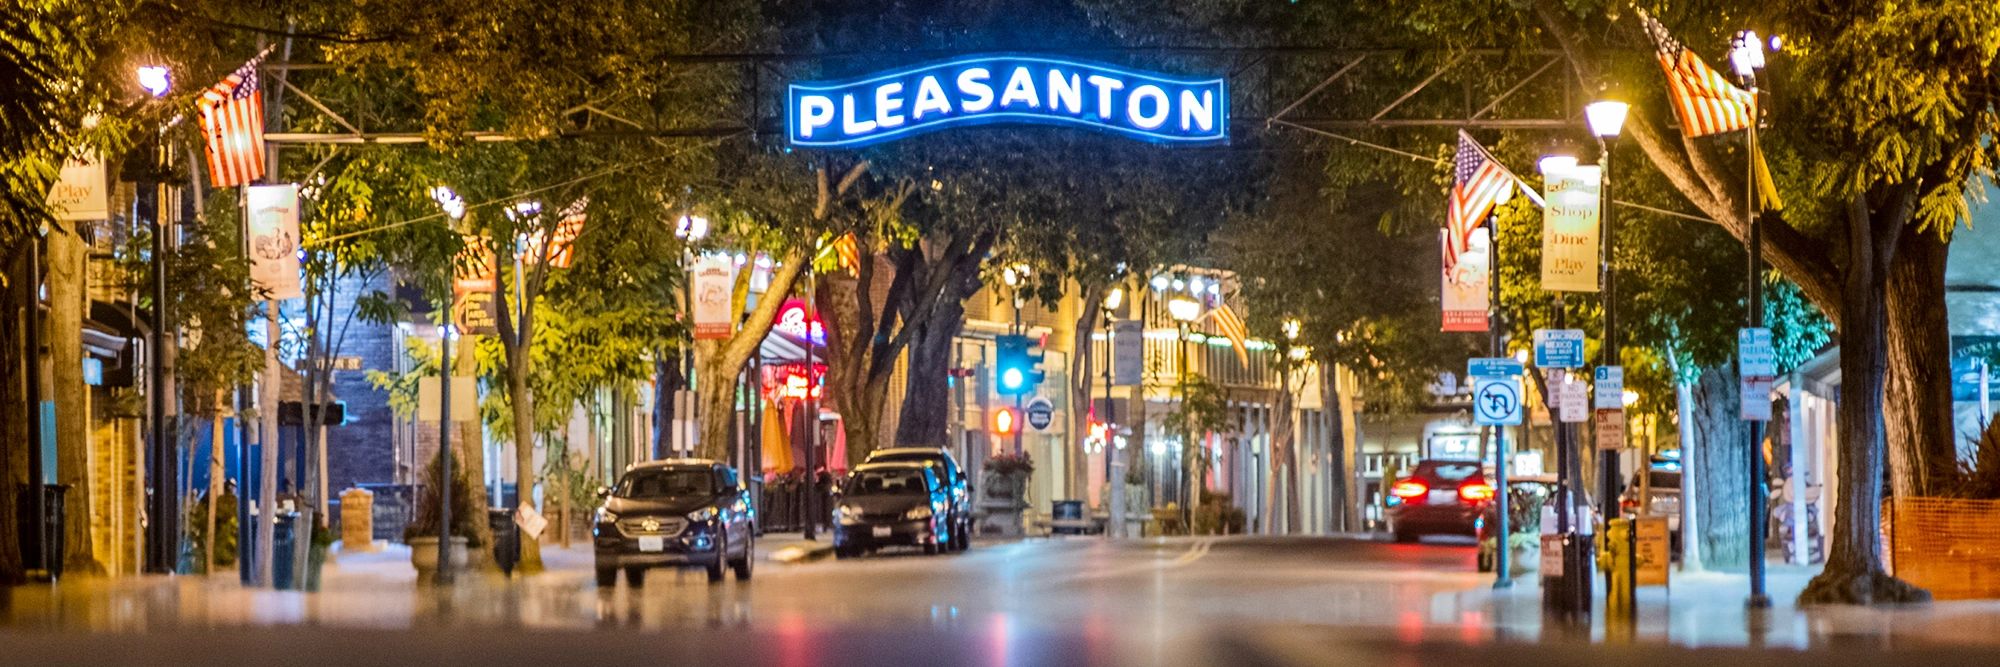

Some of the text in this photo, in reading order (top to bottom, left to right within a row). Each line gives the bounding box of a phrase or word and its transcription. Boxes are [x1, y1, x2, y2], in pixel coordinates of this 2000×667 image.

[799, 66, 1213, 138] PLEASANTON
[57, 184, 92, 200] Play
[1552, 204, 1593, 220] Shop
[1554, 232, 1589, 246] Dine
[1555, 257, 1585, 272] Play
[1545, 340, 1573, 348] MEXICO
[1599, 369, 1606, 379] 3
